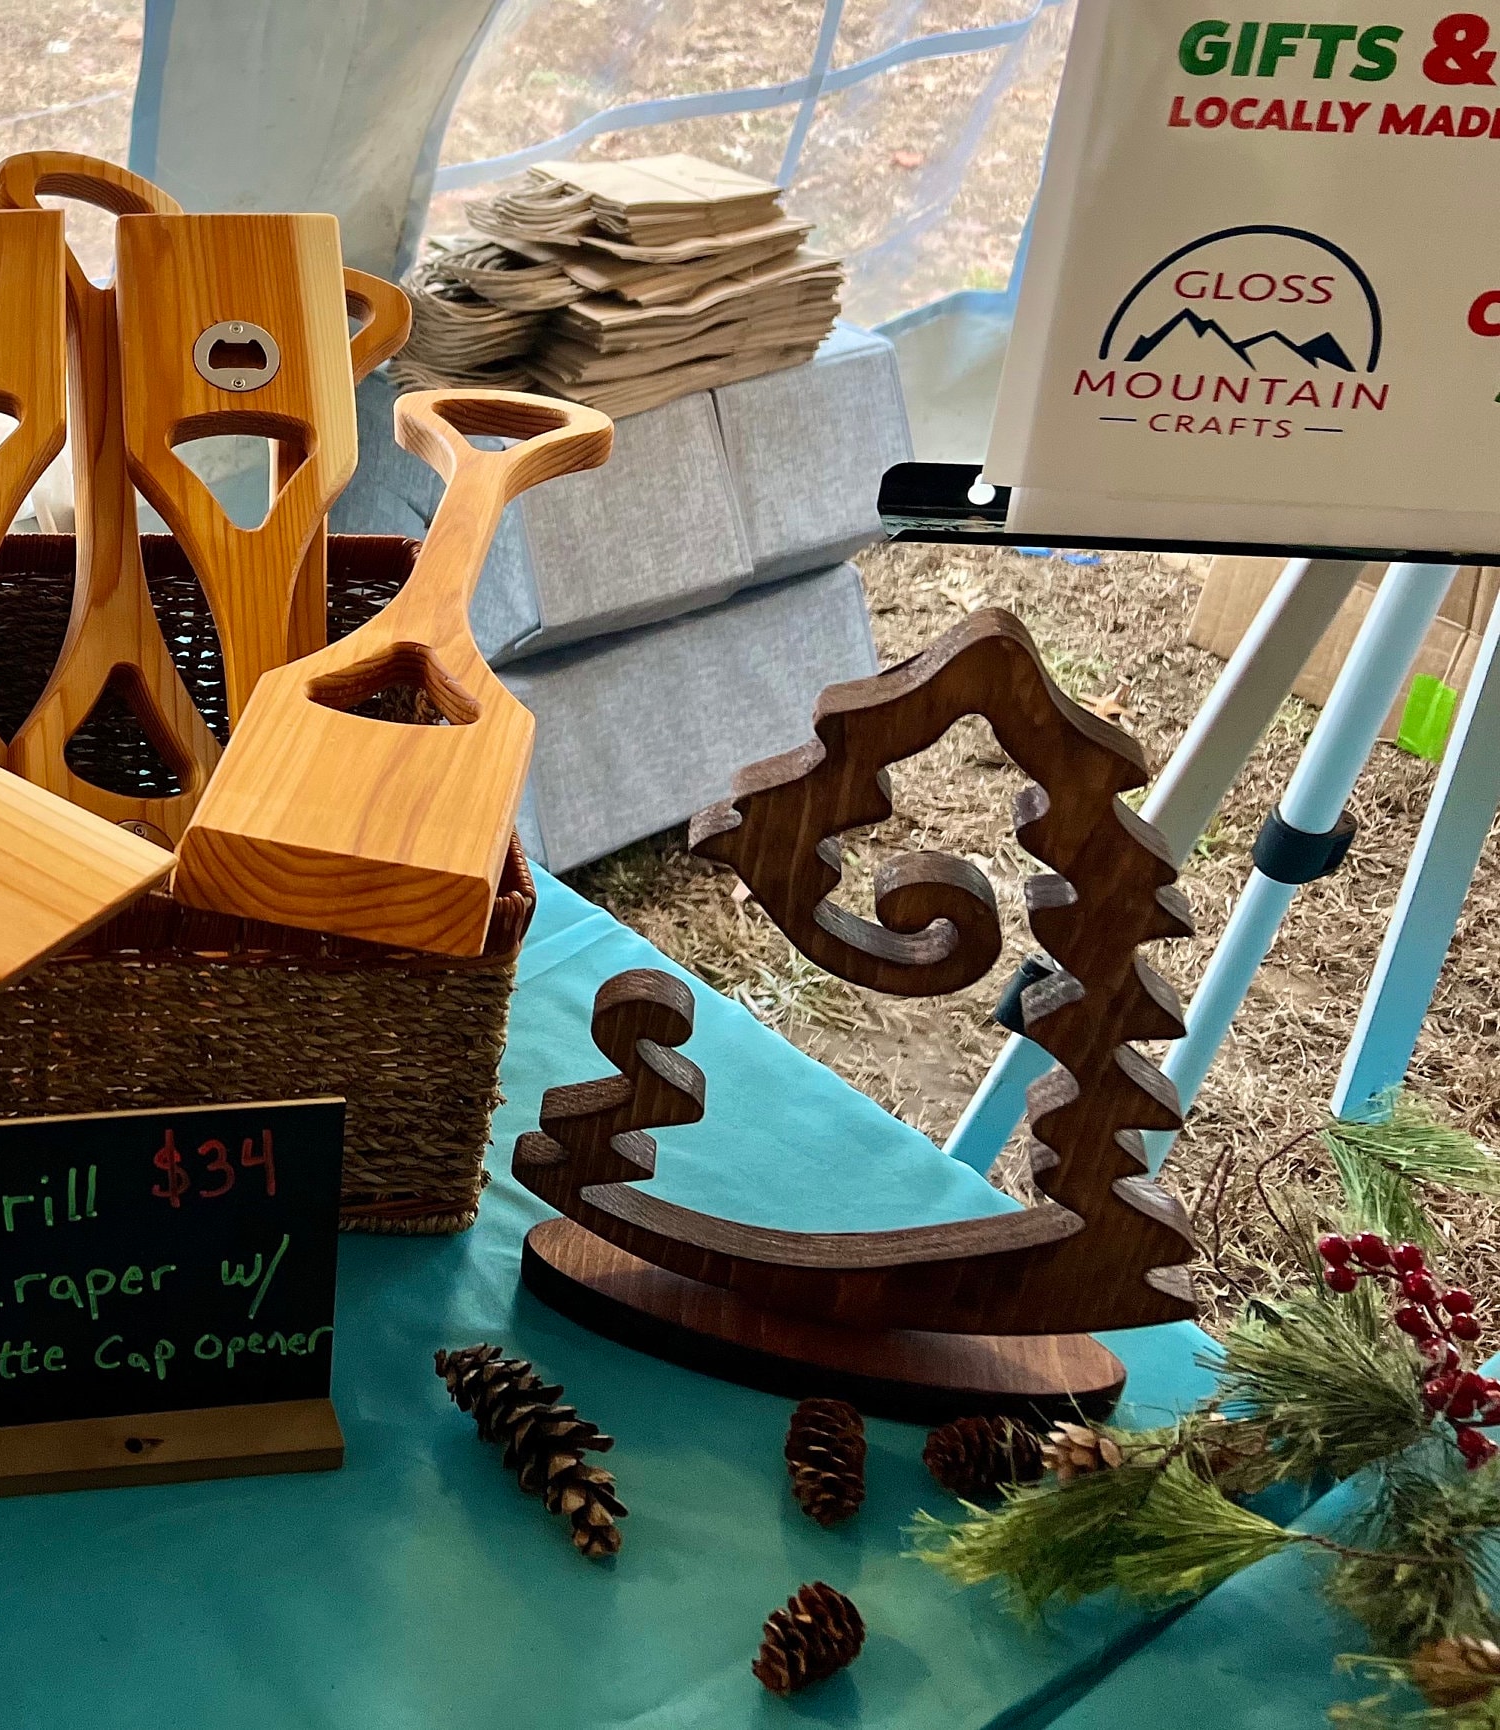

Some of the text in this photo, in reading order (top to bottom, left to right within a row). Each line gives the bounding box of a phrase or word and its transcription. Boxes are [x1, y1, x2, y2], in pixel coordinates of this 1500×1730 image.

[1179, 11, 1498, 87] GIFTS &
[1167, 96, 1371, 135] LOCALLY
[1173, 269, 1336, 305] GLOSS
[1072, 368, 1391, 412] MOUNTAIN
[1147, 412, 1293, 440] CRAFTS
[152, 1128, 277, 1208] $34
[221, 1233, 291, 1320] w/
[95, 1334, 177, 1381] Cap
